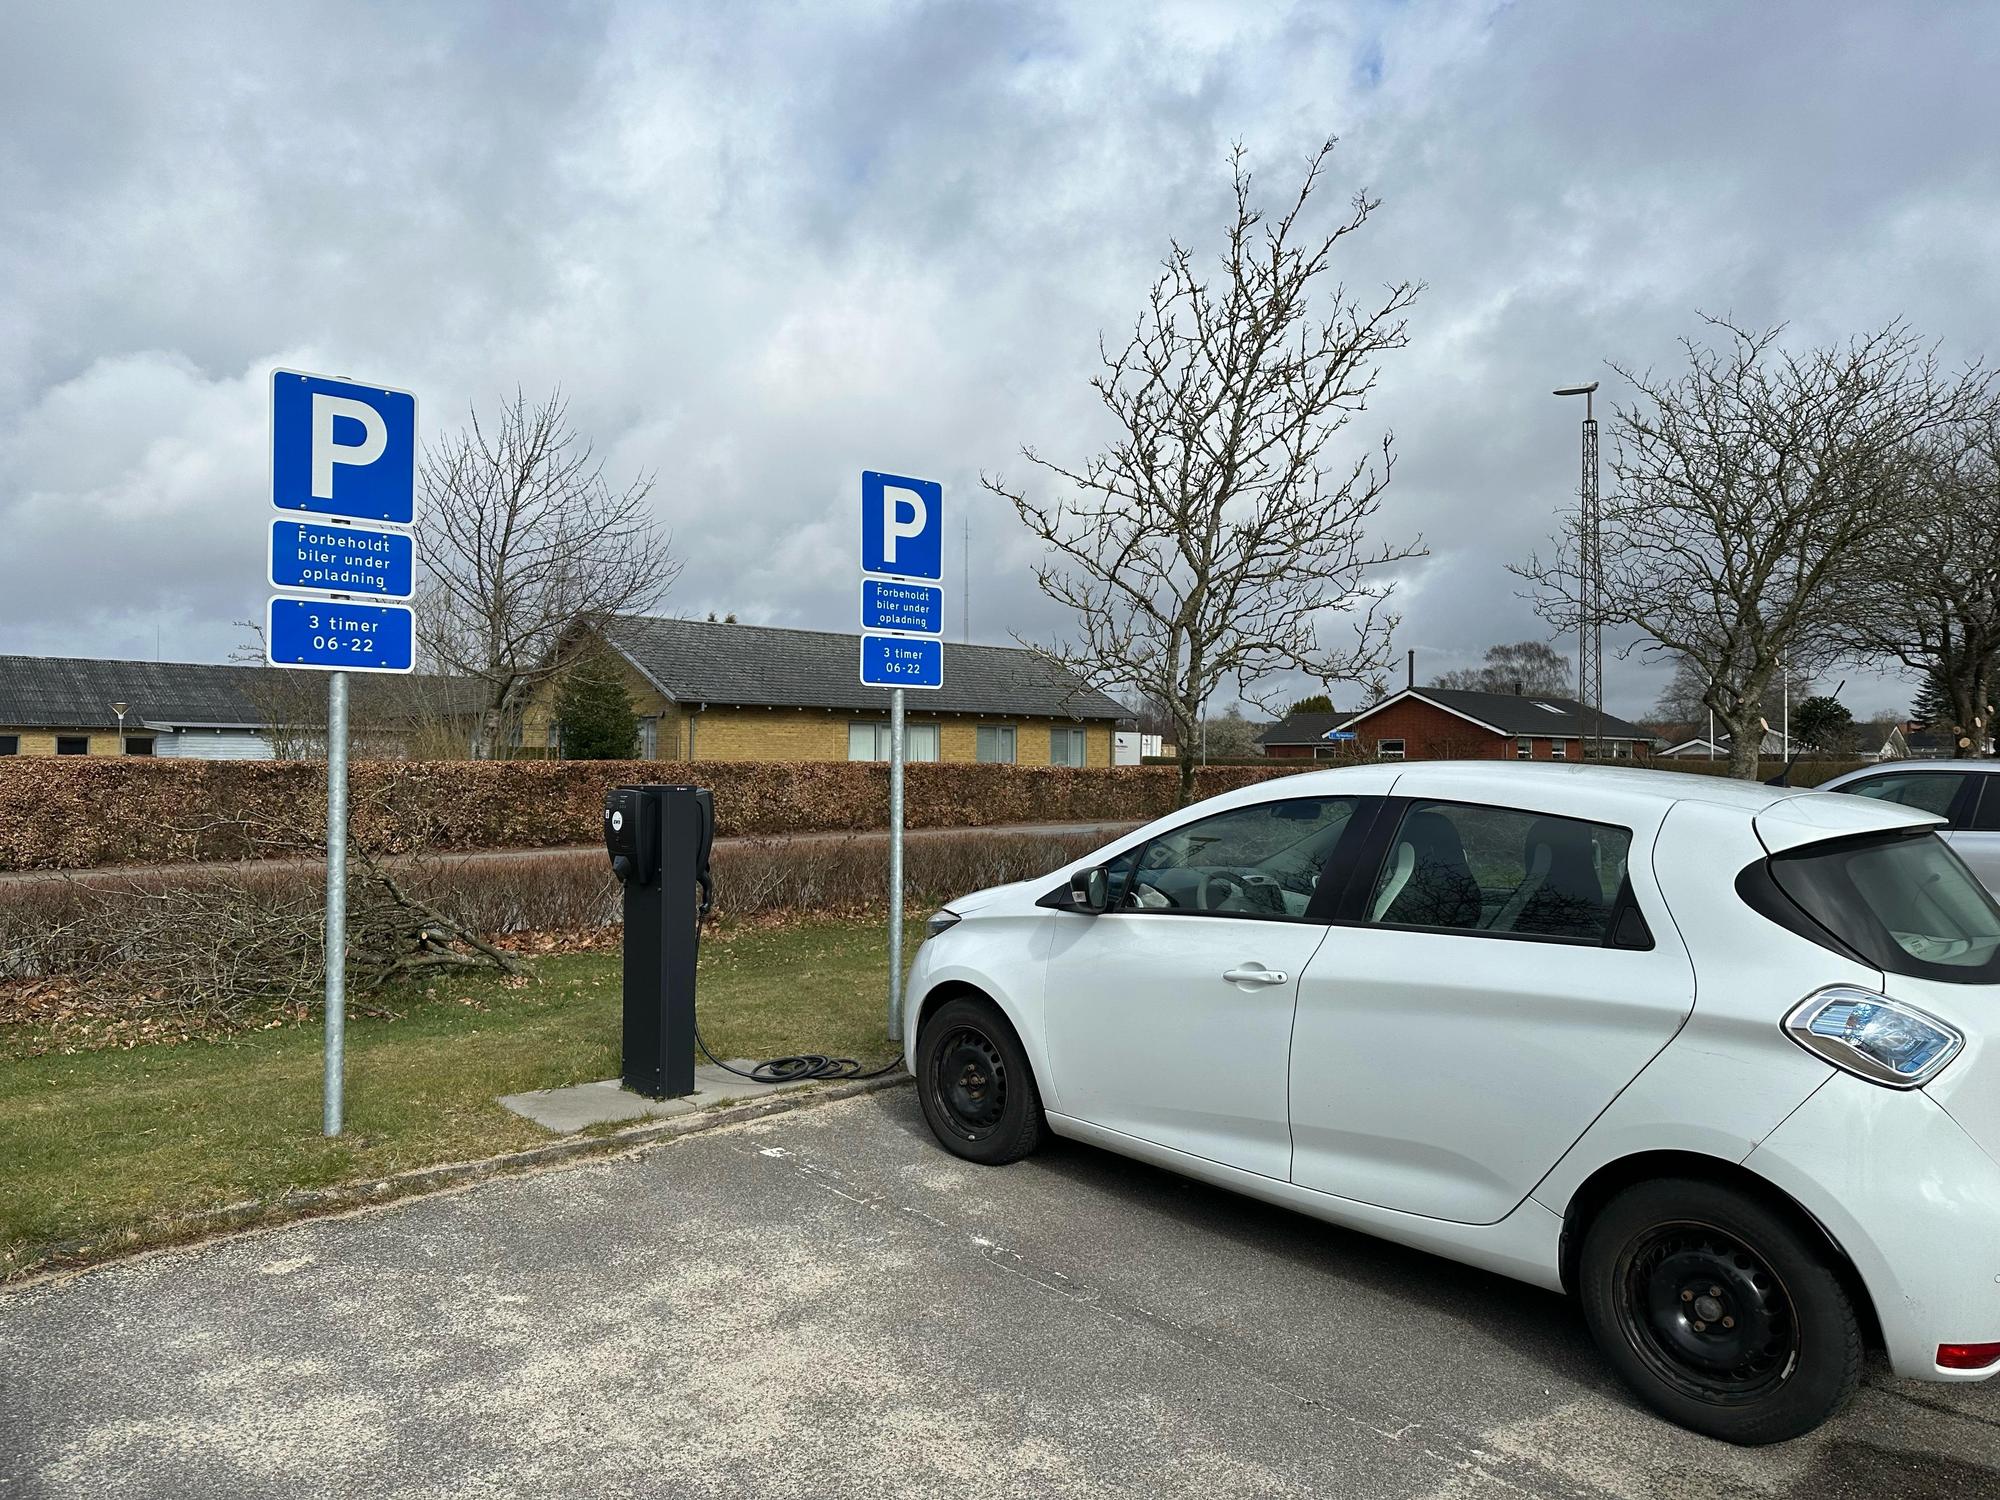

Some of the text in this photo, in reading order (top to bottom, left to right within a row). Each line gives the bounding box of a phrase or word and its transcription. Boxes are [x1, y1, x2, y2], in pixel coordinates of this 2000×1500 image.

[312, 393, 388, 499] P
[884, 485, 927, 563] P
[298, 531, 390, 552] Forbeholdt
[298, 549, 390, 569] biler under
[303, 569, 384, 588] opladning
[877, 587, 929, 601] Forbeholdt
[876, 600, 929, 613] biler under
[309, 615, 379, 632] 3 timer
[880, 614, 926, 628] opladning
[313, 636, 373, 652] 06-22
[884, 648, 922, 659] 3 timer
[886, 663, 920, 674] 06-22
